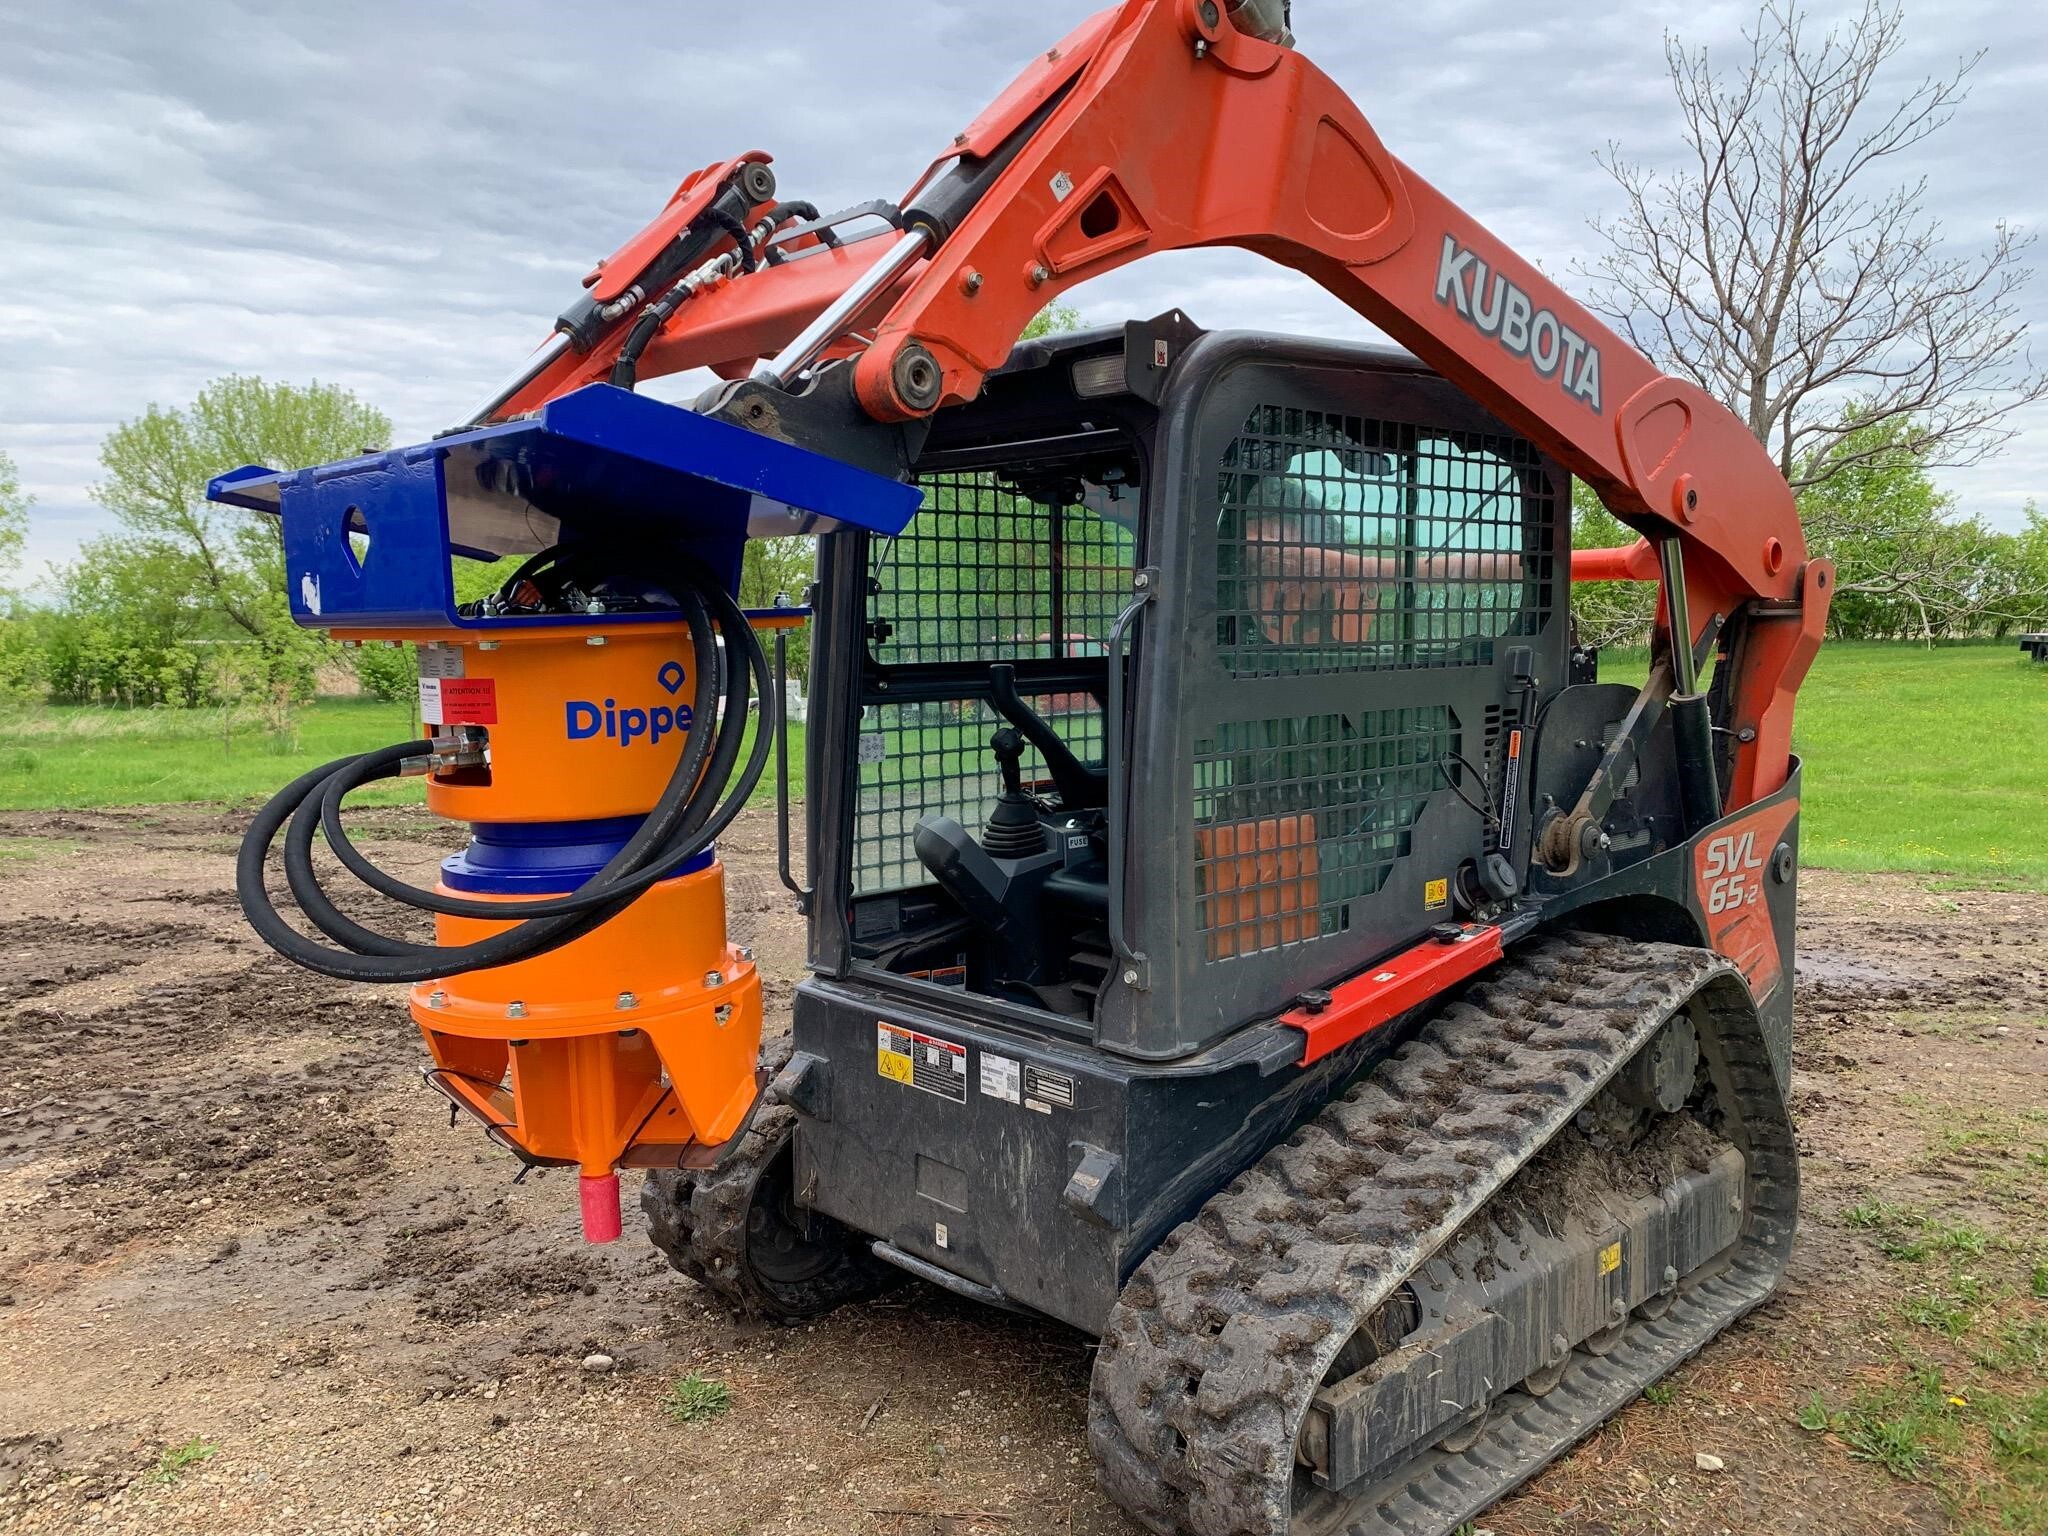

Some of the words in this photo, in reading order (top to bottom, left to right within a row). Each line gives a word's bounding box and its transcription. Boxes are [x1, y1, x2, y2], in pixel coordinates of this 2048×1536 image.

[1435, 233, 1601, 411] KUBOTA
[565, 698, 694, 748] Dippe
[1703, 832, 1763, 879] SVL
